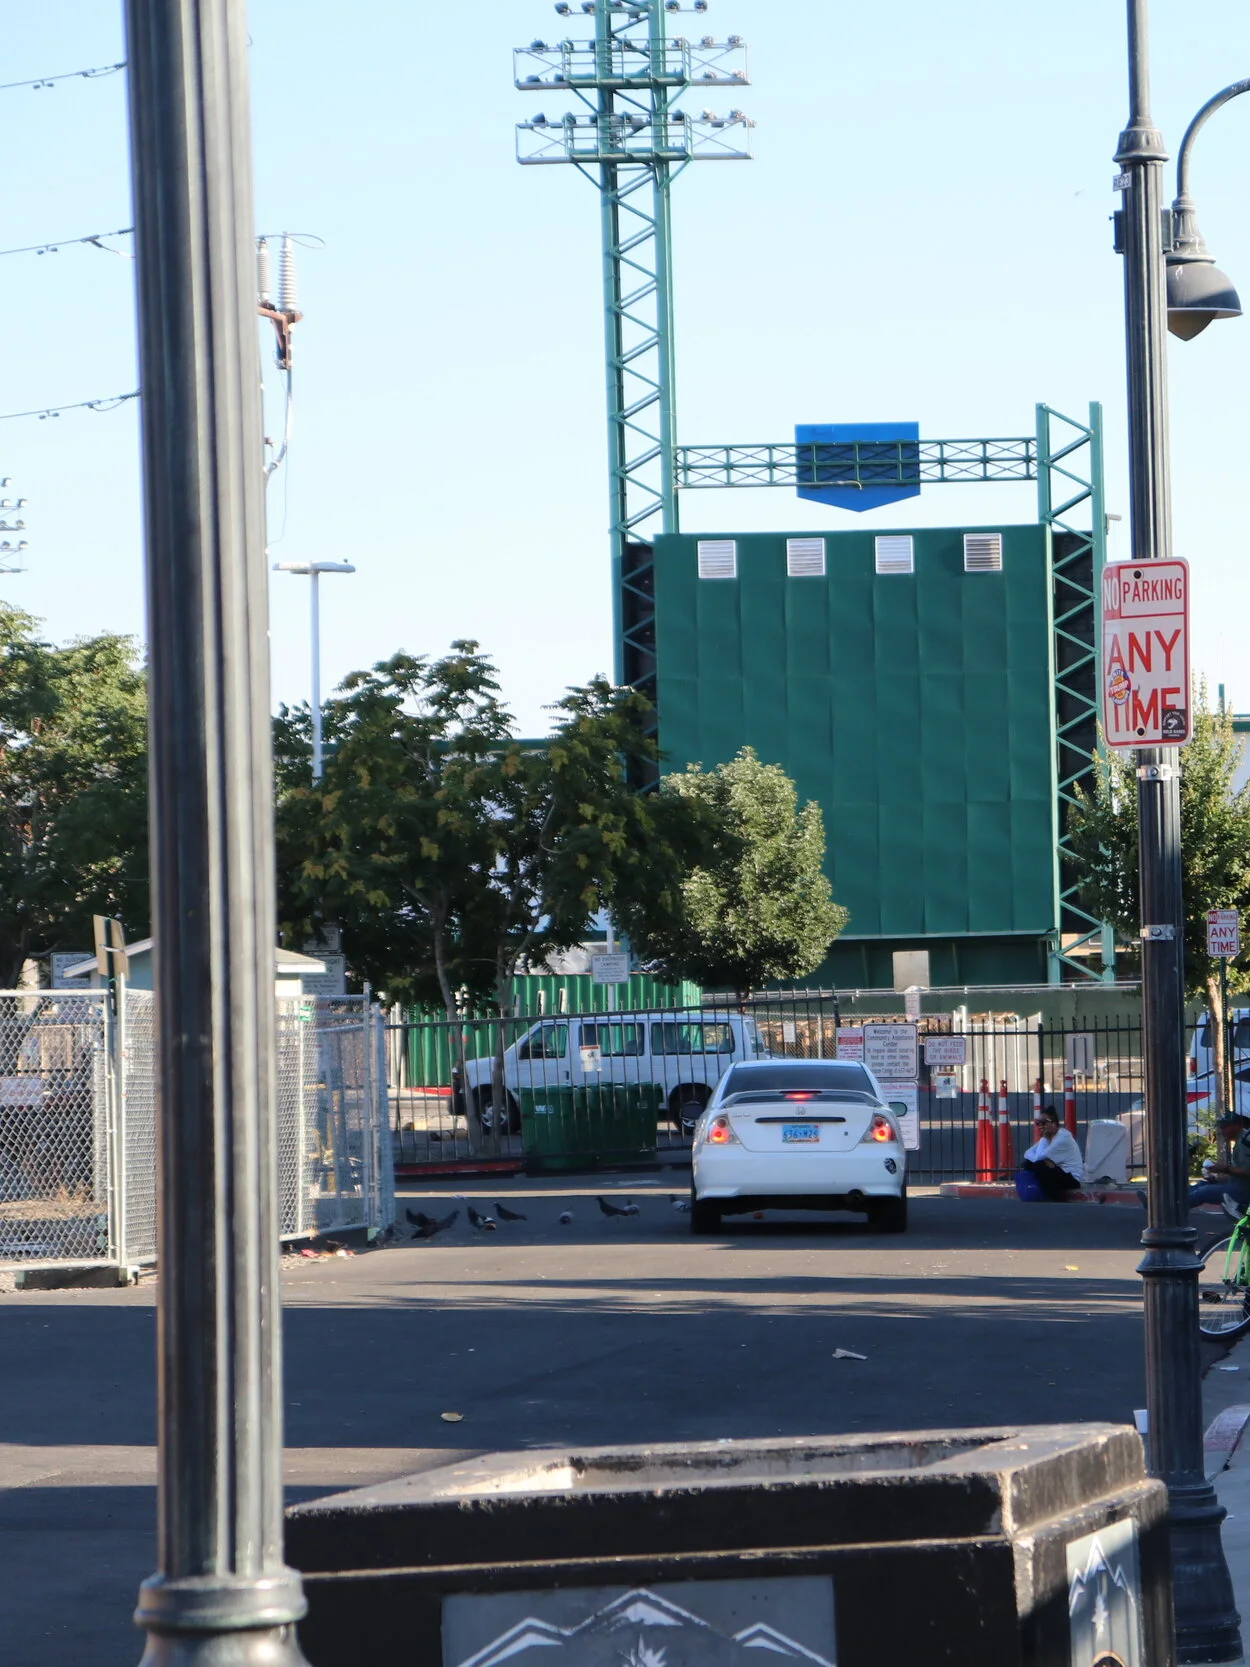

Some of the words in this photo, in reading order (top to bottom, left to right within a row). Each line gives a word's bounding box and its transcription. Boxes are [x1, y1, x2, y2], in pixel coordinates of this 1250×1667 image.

[1104, 578, 1119, 612] NO
[1123, 578, 1182, 603] PARKING
[1107, 629, 1182, 675] ANY
[1110, 679, 1128, 695] TRUMP
[1210, 927, 1236, 938] ANY
[1210, 941, 1236, 952] TIME
